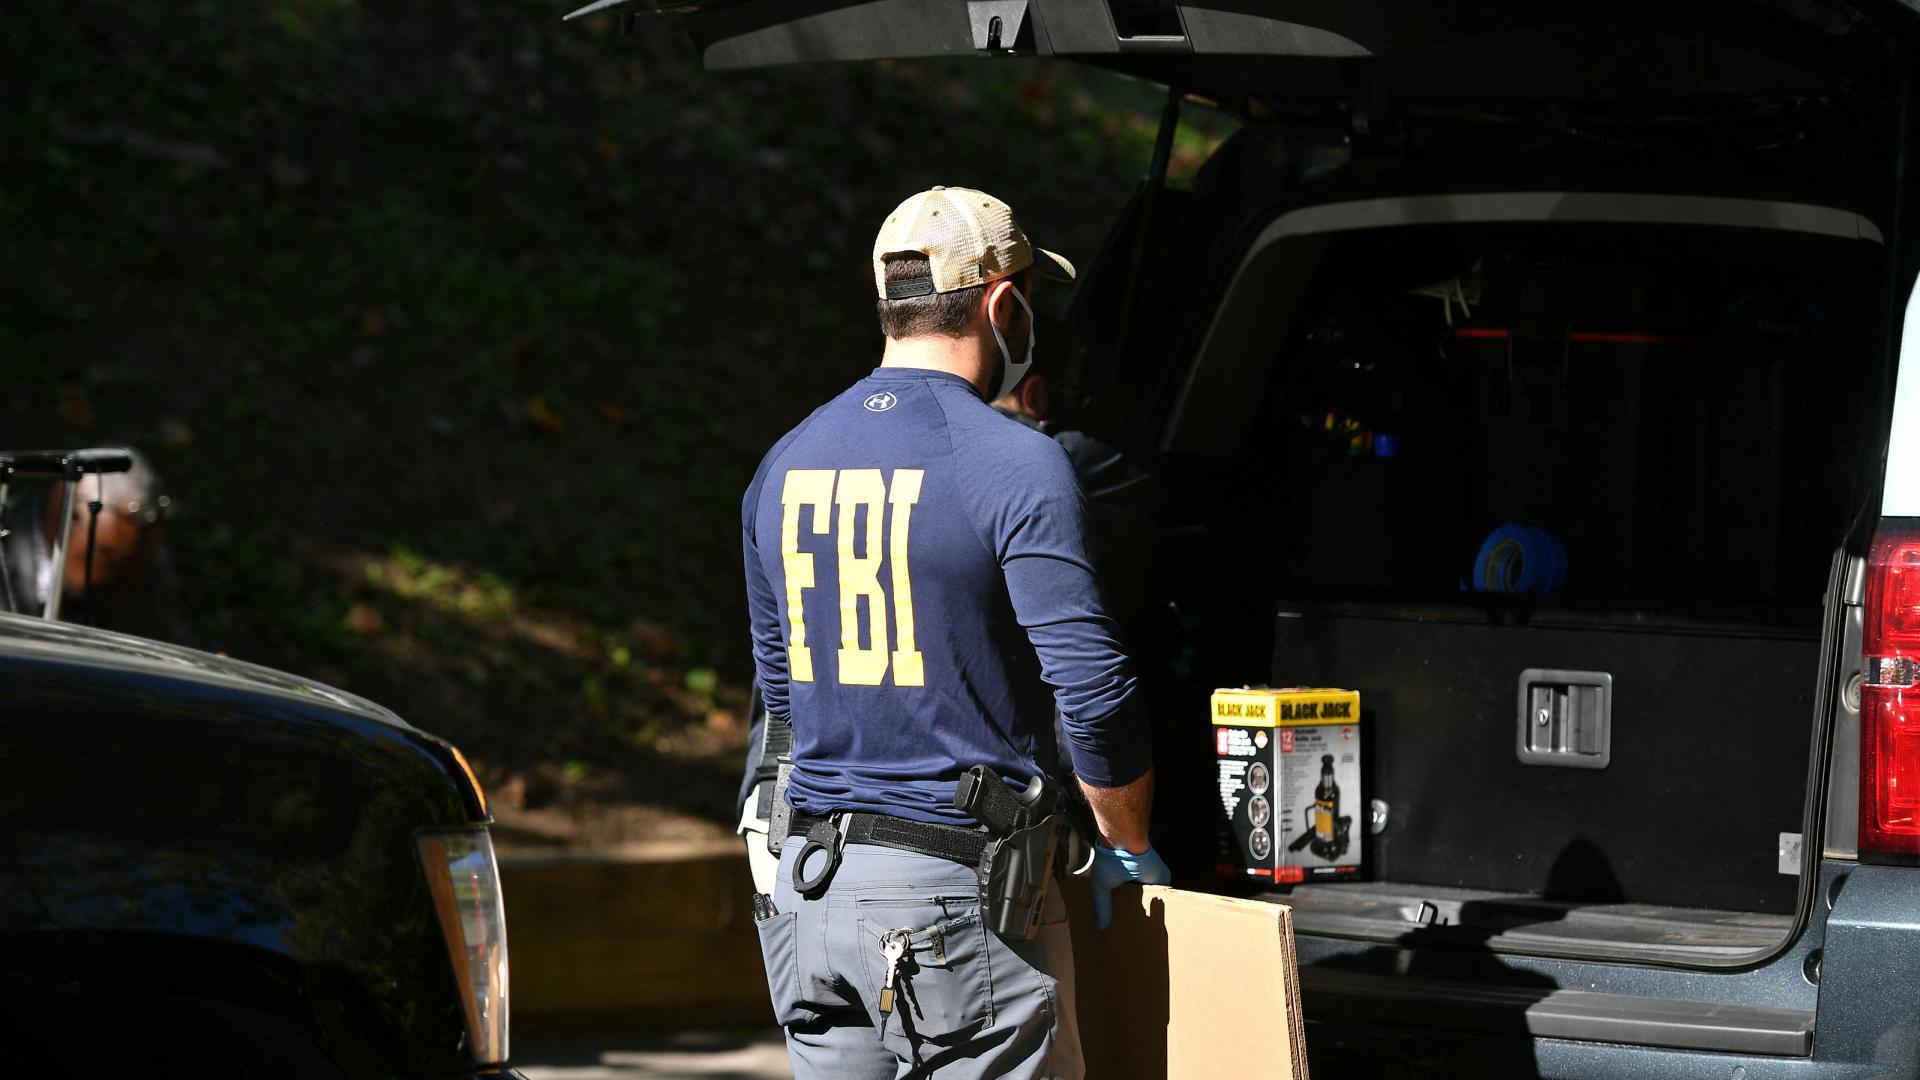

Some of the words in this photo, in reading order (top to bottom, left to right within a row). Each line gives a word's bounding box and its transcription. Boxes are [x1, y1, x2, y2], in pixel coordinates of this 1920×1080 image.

[781, 468, 925, 687] FBI
[1217, 703, 1242, 717] BLACK
[1245, 704, 1266, 718] JACK
[1281, 703, 1318, 720] BLACK
[1321, 702, 1352, 718] JACK
